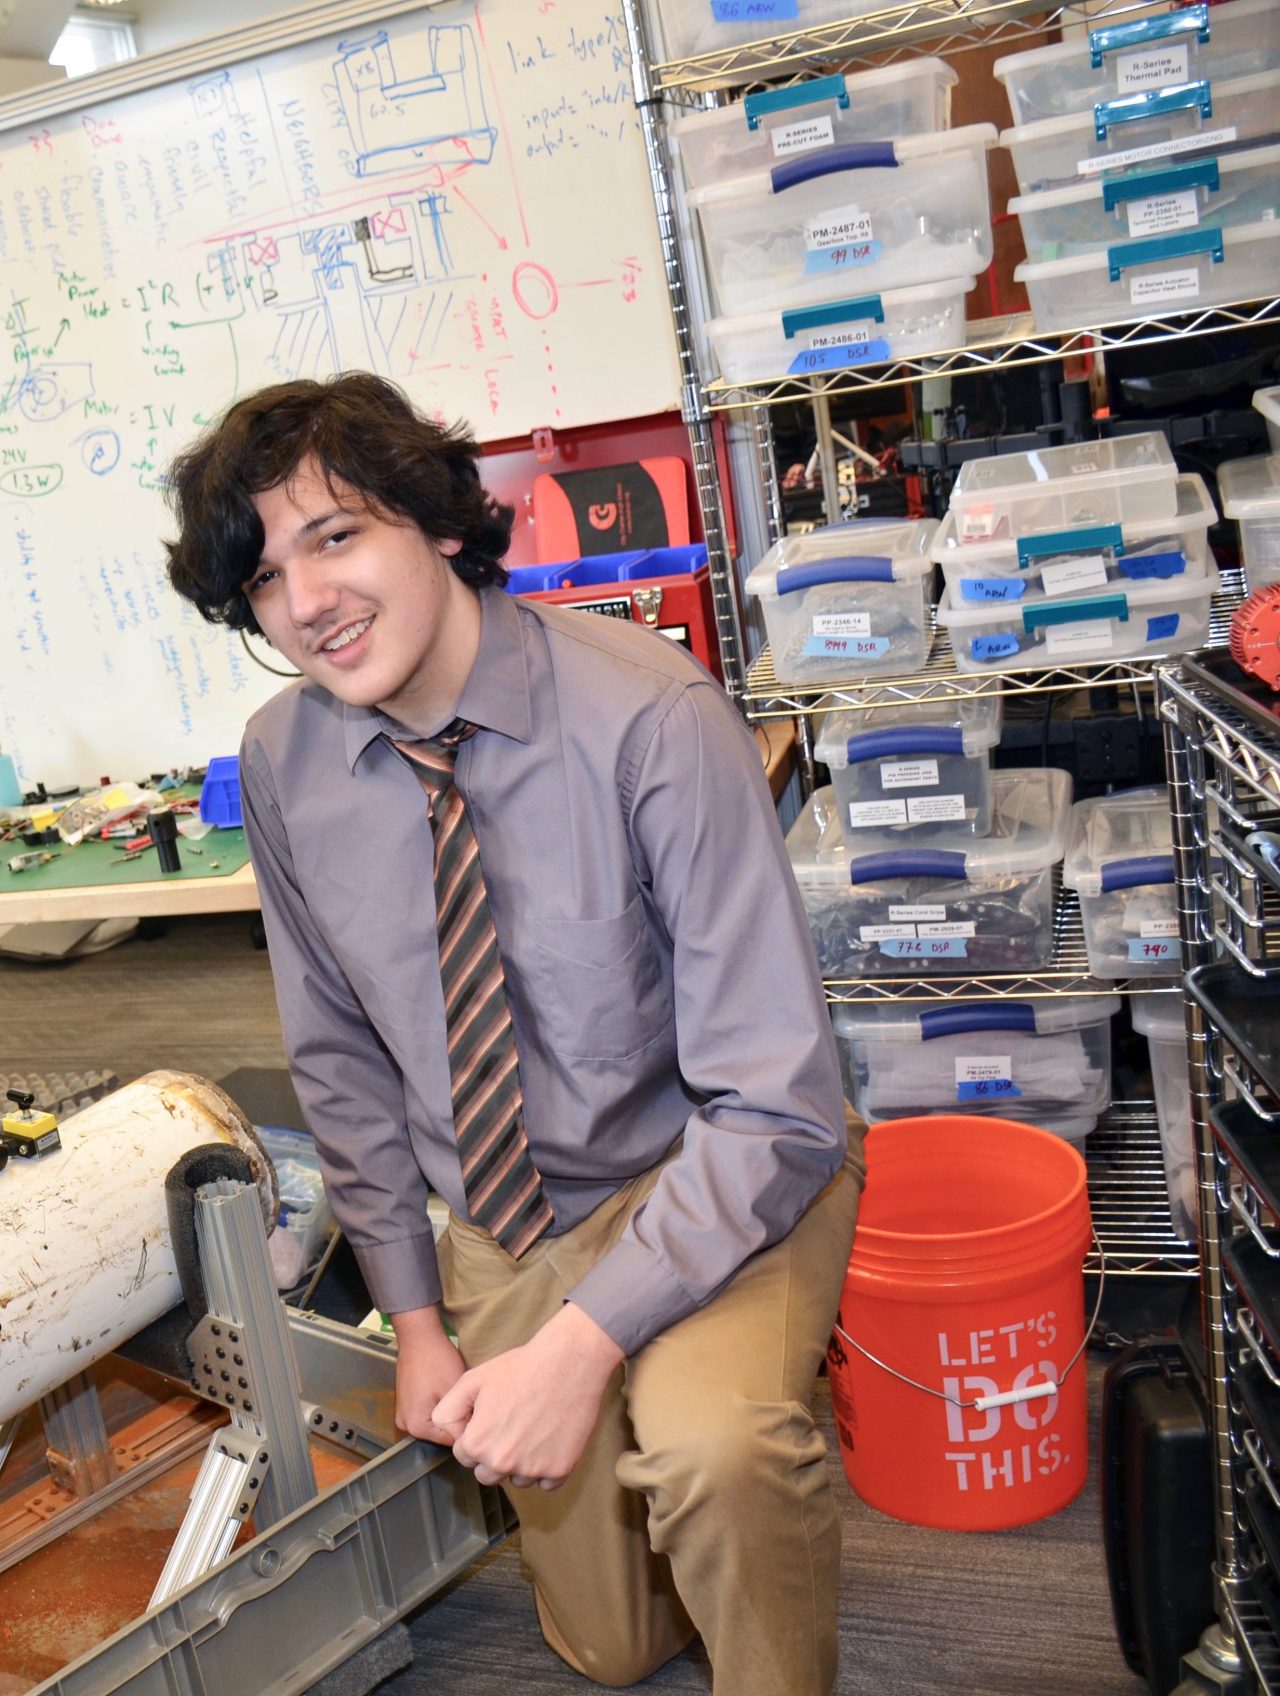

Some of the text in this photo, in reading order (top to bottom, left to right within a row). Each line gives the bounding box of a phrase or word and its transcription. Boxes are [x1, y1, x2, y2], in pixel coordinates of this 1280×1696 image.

[1132, 58, 1172, 71] R-Series
[1125, 66, 1182, 83] Thermal Pad
[777, 132, 830, 149] PRE-CUT FOAM
[786, 126, 818, 139] R-SERIES
[1124, 149, 1154, 162] MOTOR
[812, 219, 871, 239] PM-2487-01
[812, 332, 867, 348] PM-2486-01
[938, 1311, 1057, 1366] LET'S
[943, 1360, 1059, 1443] DO
[945, 1433, 1071, 1491] THIS.
